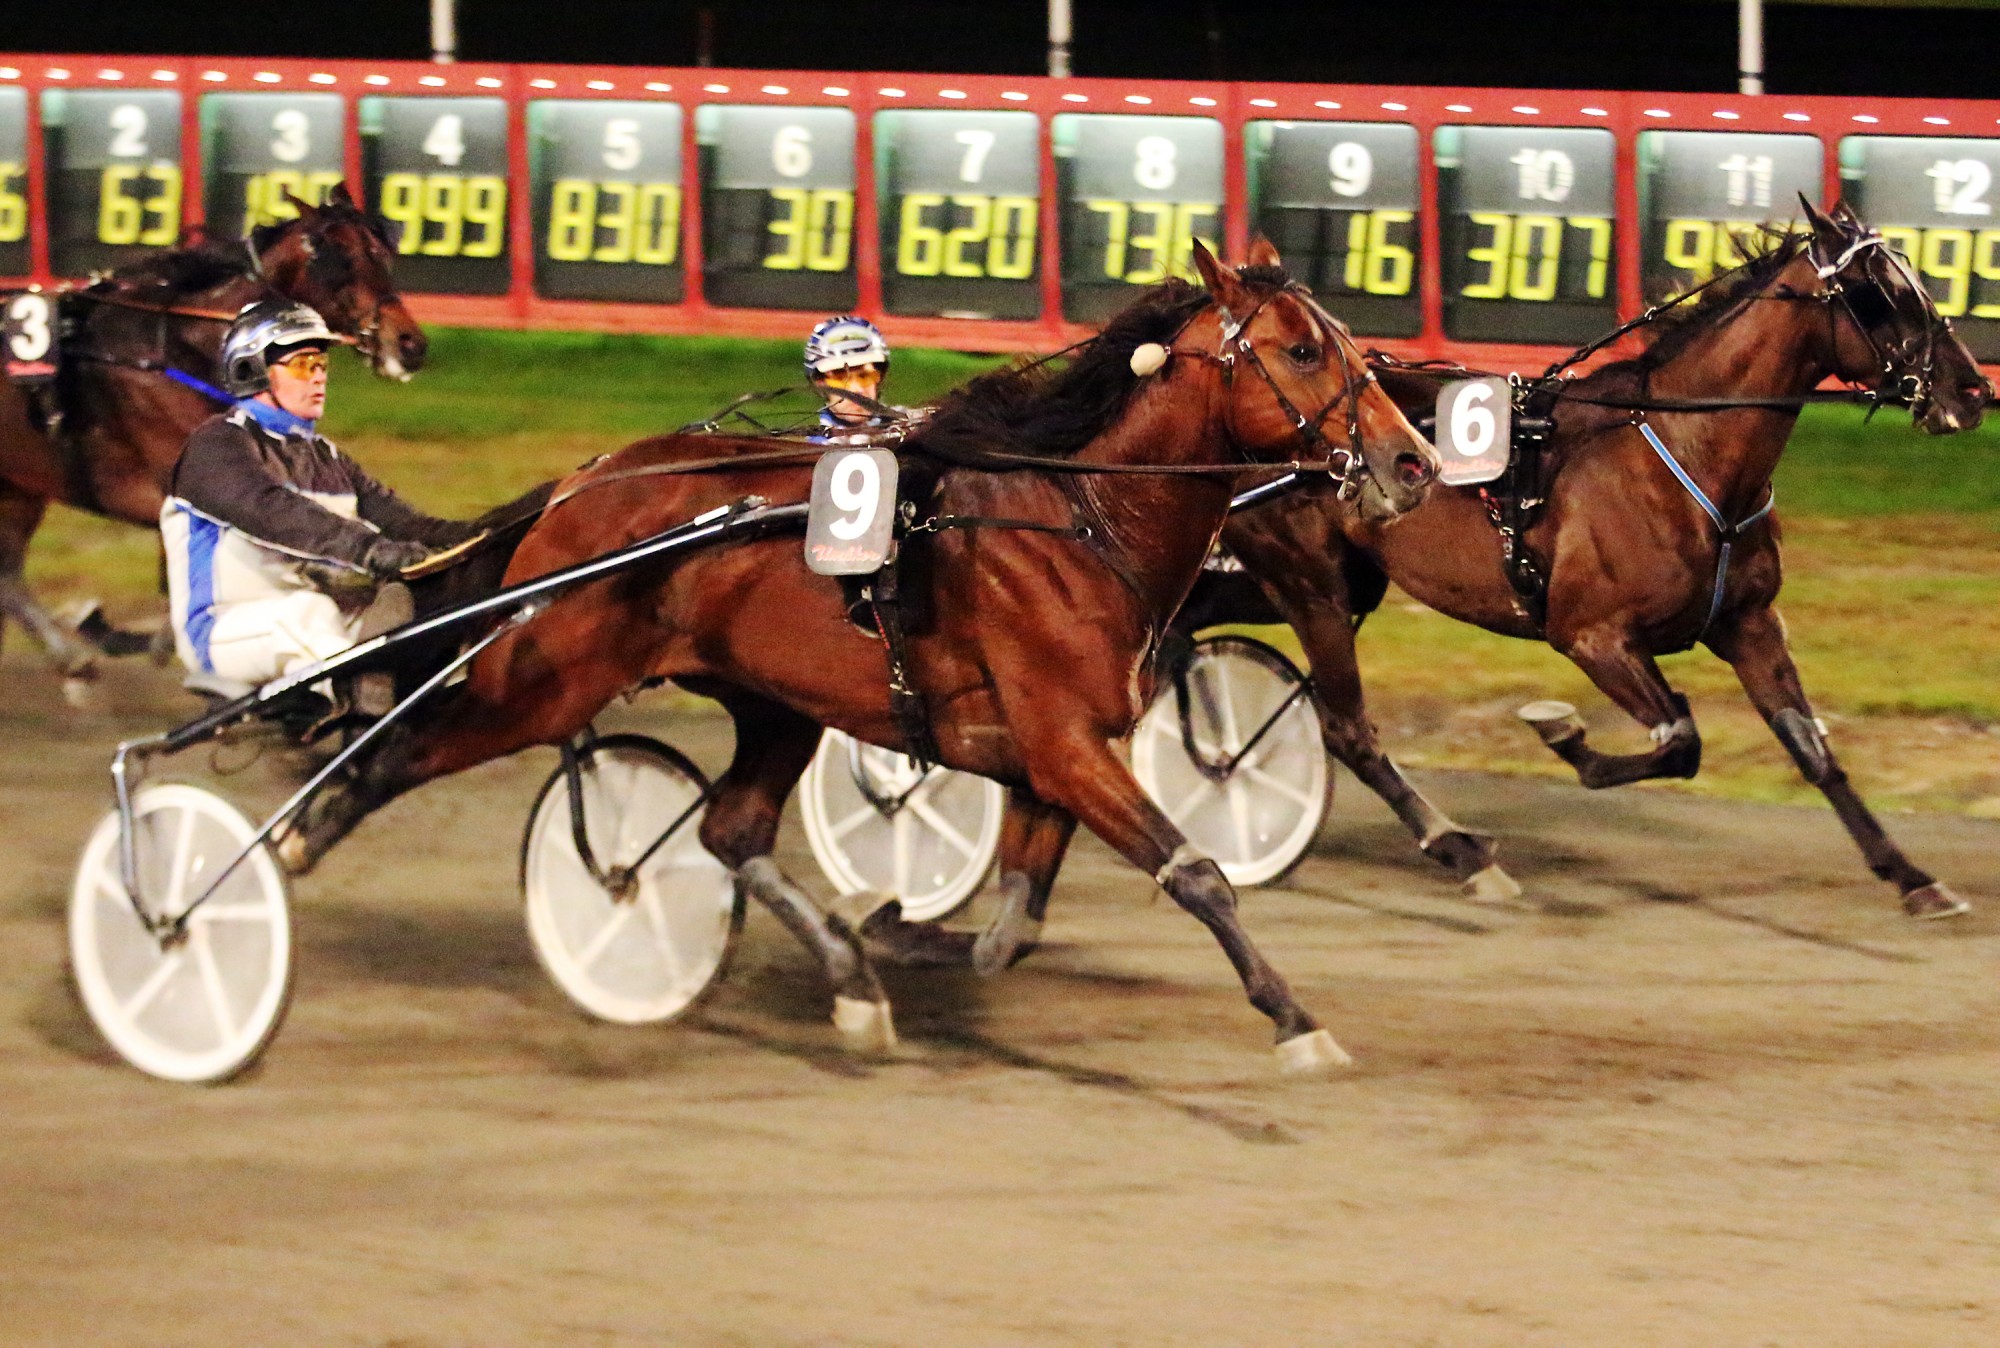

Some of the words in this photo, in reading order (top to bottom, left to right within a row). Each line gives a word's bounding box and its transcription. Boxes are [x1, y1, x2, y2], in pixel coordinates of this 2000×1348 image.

[109, 104, 147, 157] 2
[271, 109, 309, 162] 3
[422, 114, 464, 165] 4
[602, 119, 641, 170] 5
[772, 125, 812, 177] 6
[955, 130, 995, 182] 7
[1133, 136, 1176, 190] 8
[1328, 142, 1372, 197] 9
[1510, 148, 1574, 201] 10
[1719, 153, 1773, 207] 11
[1925, 159, 1992, 215] 12
[98, 164, 182, 246] 63
[381, 173, 507, 258] 999
[548, 179, 681, 264] 830
[763, 187, 854, 271] 30
[898, 193, 1038, 278] 620
[1345, 210, 1414, 295] 16
[1461, 213, 1612, 300] 307
[10, 294, 51, 361] 3
[1451, 383, 1495, 456] 6
[829, 453, 880, 540] 9
